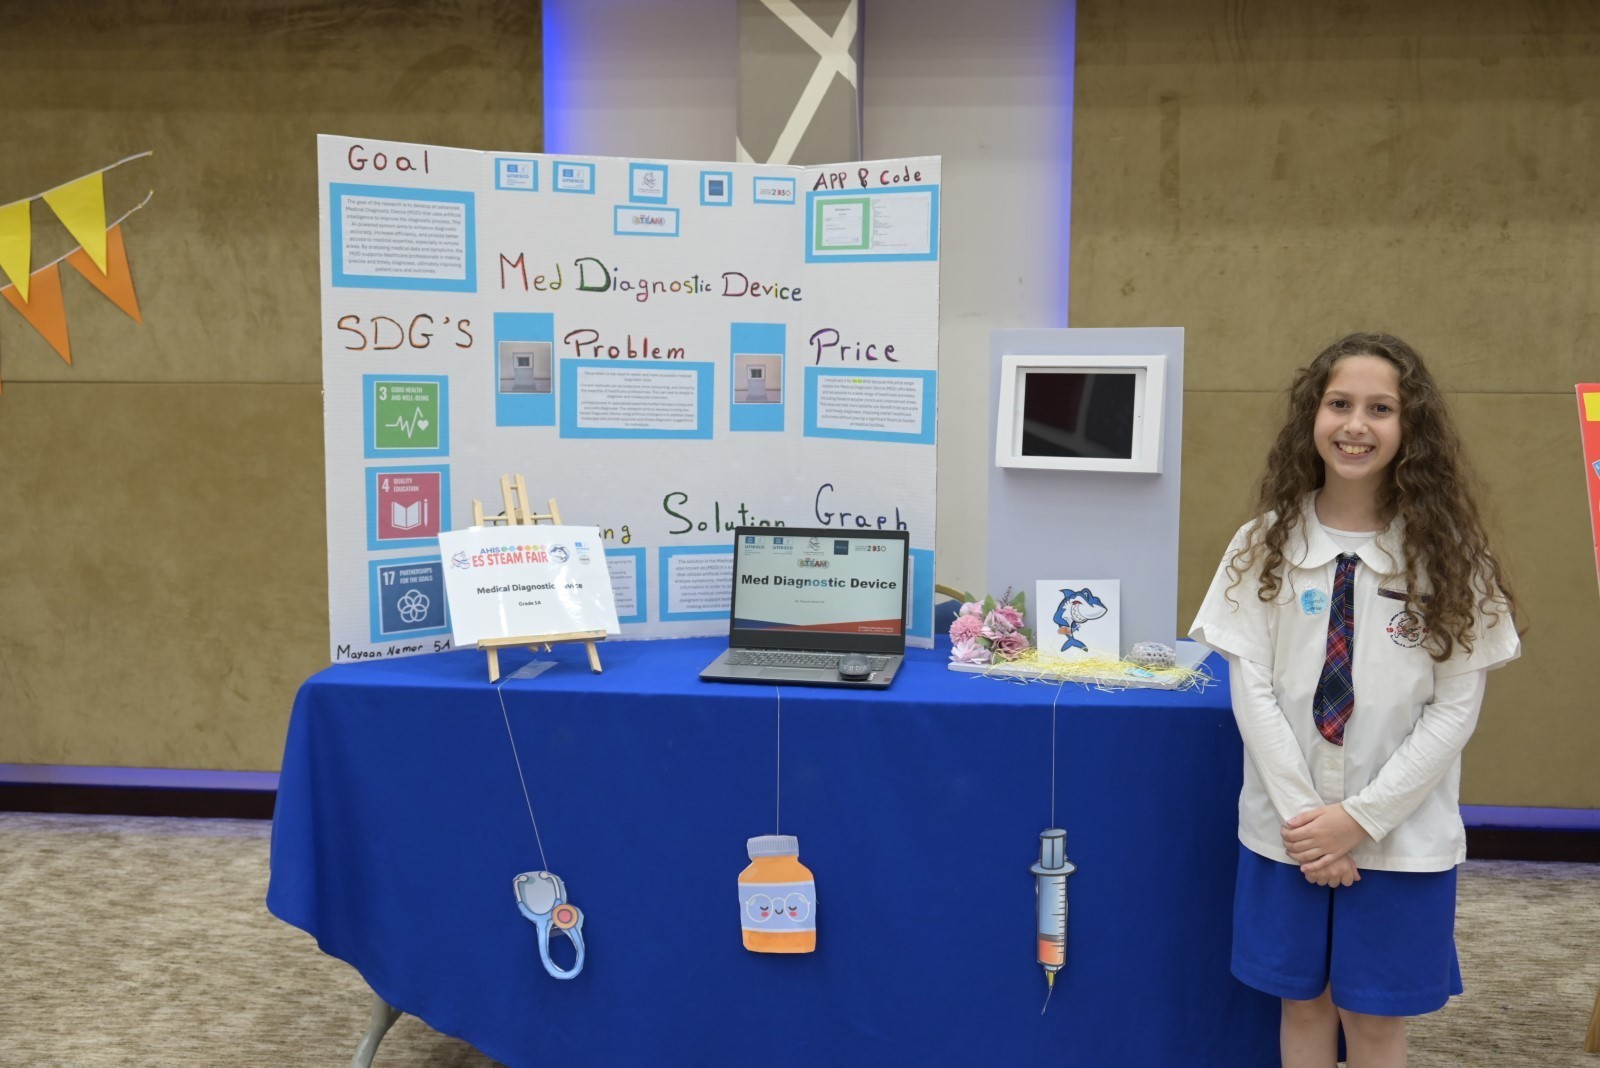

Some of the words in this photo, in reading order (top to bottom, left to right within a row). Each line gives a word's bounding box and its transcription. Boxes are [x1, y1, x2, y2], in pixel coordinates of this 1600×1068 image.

[348, 145, 428, 174] Goal
[813, 172, 847, 191] APP
[880, 165, 922, 185] Code
[500, 252, 562, 292] Med
[574, 257, 712, 302] Diagnostic
[722, 272, 803, 301] Device
[564, 328, 685, 359] Problem
[810, 328, 900, 365] Price
[380, 386, 387, 400] 3
[382, 478, 390, 492] 4
[816, 483, 907, 530] Graph
[472, 556, 484, 567] ES
[487, 553, 524, 566] STEAM
[526, 551, 548, 564] FAIR
[382, 570, 395, 586] 17
[742, 575, 769, 584] Med
[774, 576, 846, 588] Diagnostic
[850, 578, 896, 589] Device
[477, 585, 510, 594] Medical
[512, 582, 555, 592] Diagnostic
[434, 640, 450, 652] 5A
